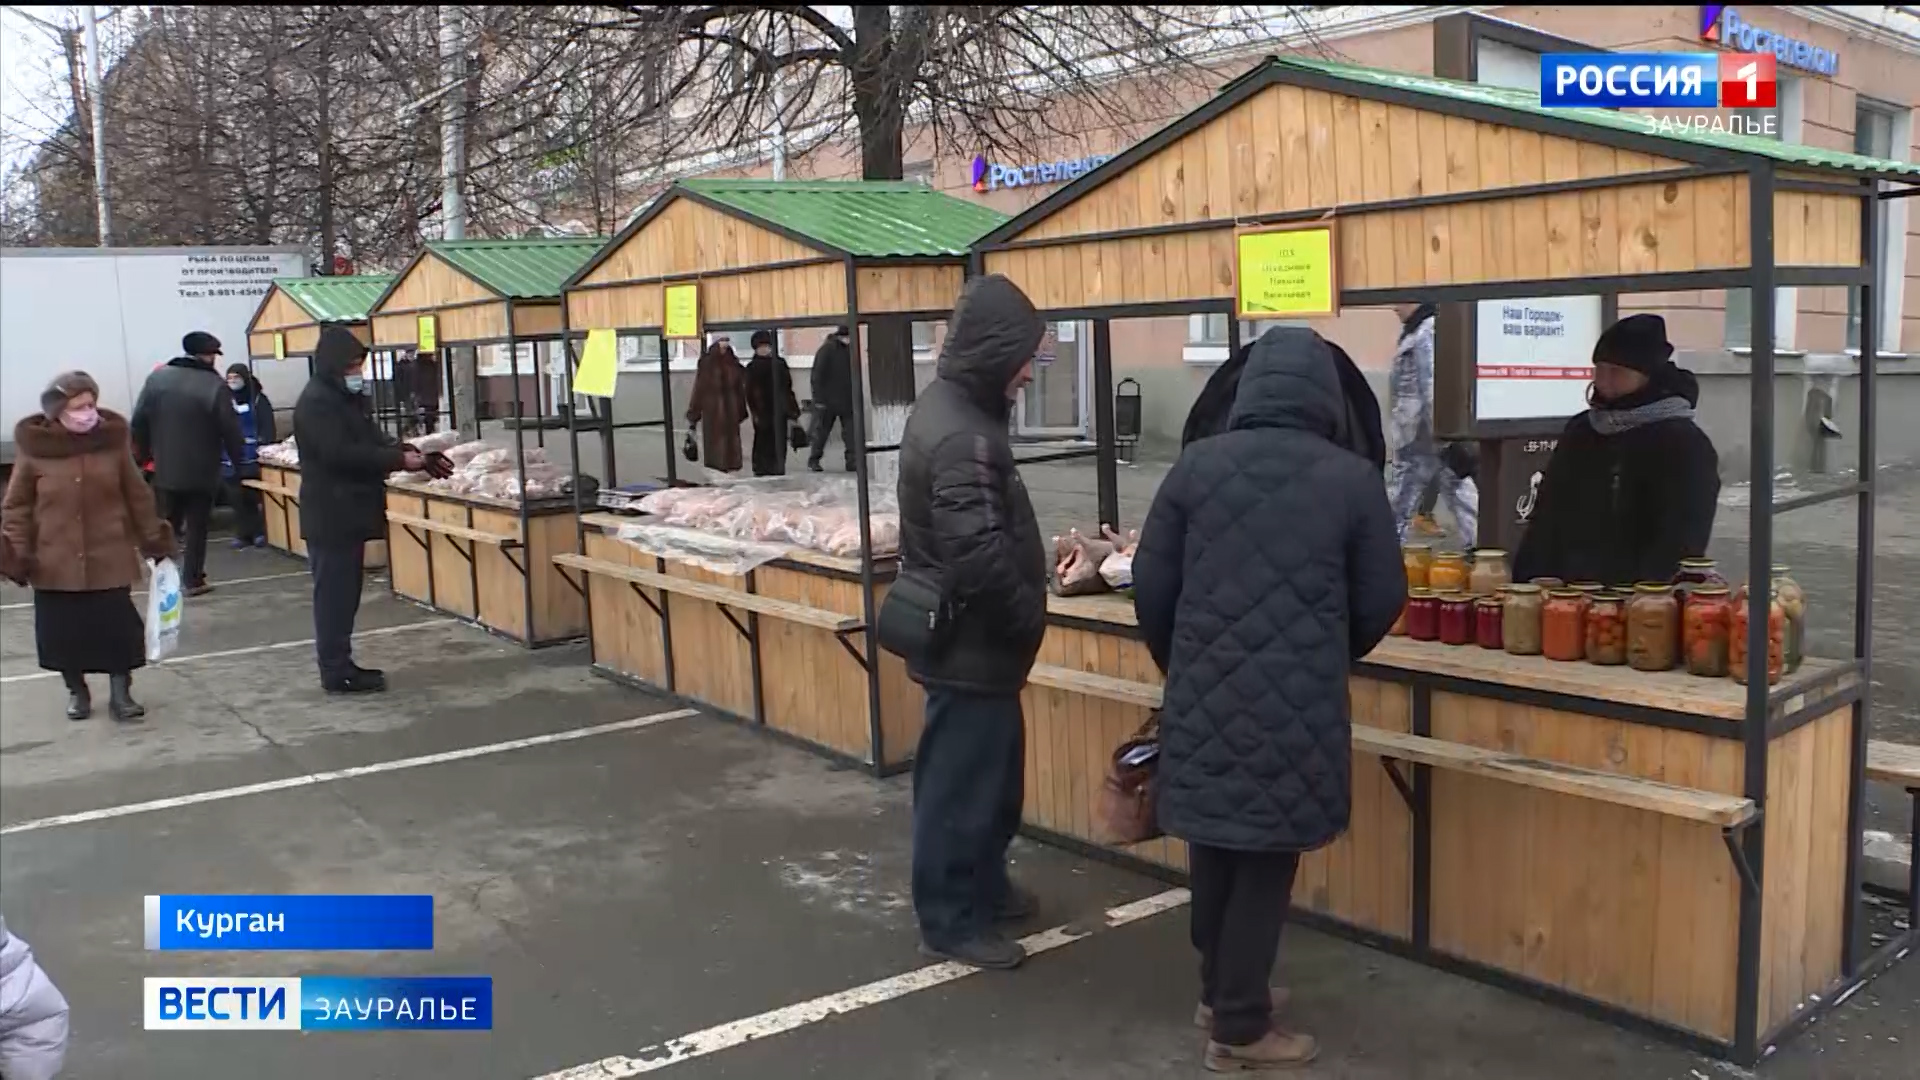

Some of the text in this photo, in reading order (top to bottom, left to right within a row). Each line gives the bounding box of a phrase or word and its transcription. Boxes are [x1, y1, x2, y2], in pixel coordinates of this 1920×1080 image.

[220, 255, 234, 263] ПО
[235, 255, 270, 263] ЦЕНАМ
[1502, 306, 1564, 323] Наш Городок-
[1503, 324, 1564, 339] ваш вариант!
